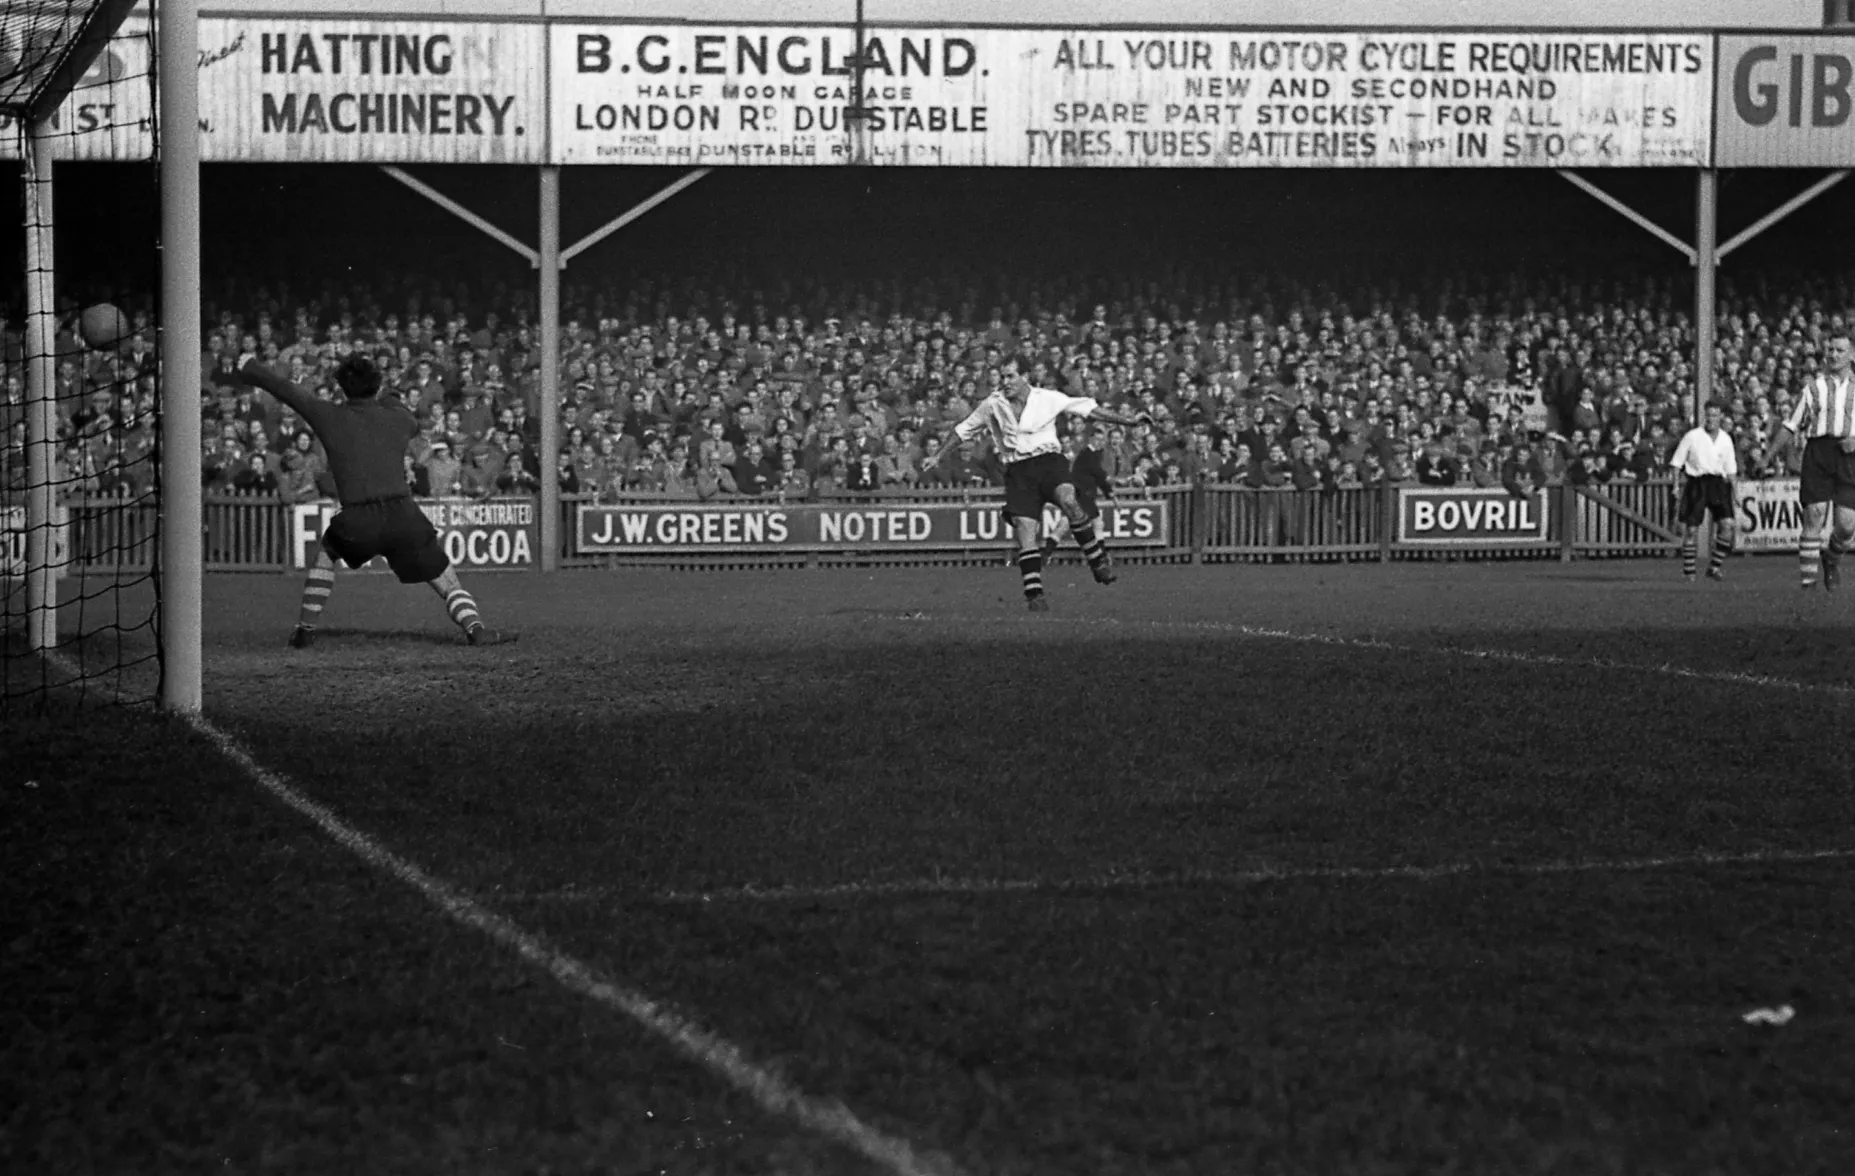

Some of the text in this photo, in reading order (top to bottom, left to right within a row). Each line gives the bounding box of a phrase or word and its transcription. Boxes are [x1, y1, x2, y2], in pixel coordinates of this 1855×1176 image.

[261, 33, 451, 74] HATTING
[1053, 39, 1701, 74] ALL YOUR MOTOR CYCLE REQUIREMENTS
[638, 85, 702, 99] HALF
[722, 86, 796, 99] MOON
[1185, 78, 1557, 100] NEW AND SECONDHAND
[262, 93, 526, 134] MACHINERY.
[576, 103, 720, 131] LONDON
[1053, 103, 1148, 123] SPARE
[1165, 104, 1242, 124] PART
[1257, 104, 1395, 126] STOCKIST
[1437, 105, 1492, 126] FOR
[1508, 107, 1562, 128] ALL
[700, 145, 816, 157] DUNSTABLE
[1228, 132, 1377, 158] BATTERIES
[1457, 132, 1488, 158] IN
[450, 504, 533, 526] CONCENTRATED
[819, 511, 931, 541] NOTED
[960, 510, 1062, 540] LUN
[1414, 500, 1536, 532] BOVRIL
[1741, 496, 1804, 534] SWAN
[436, 528, 533, 565] OCOA
